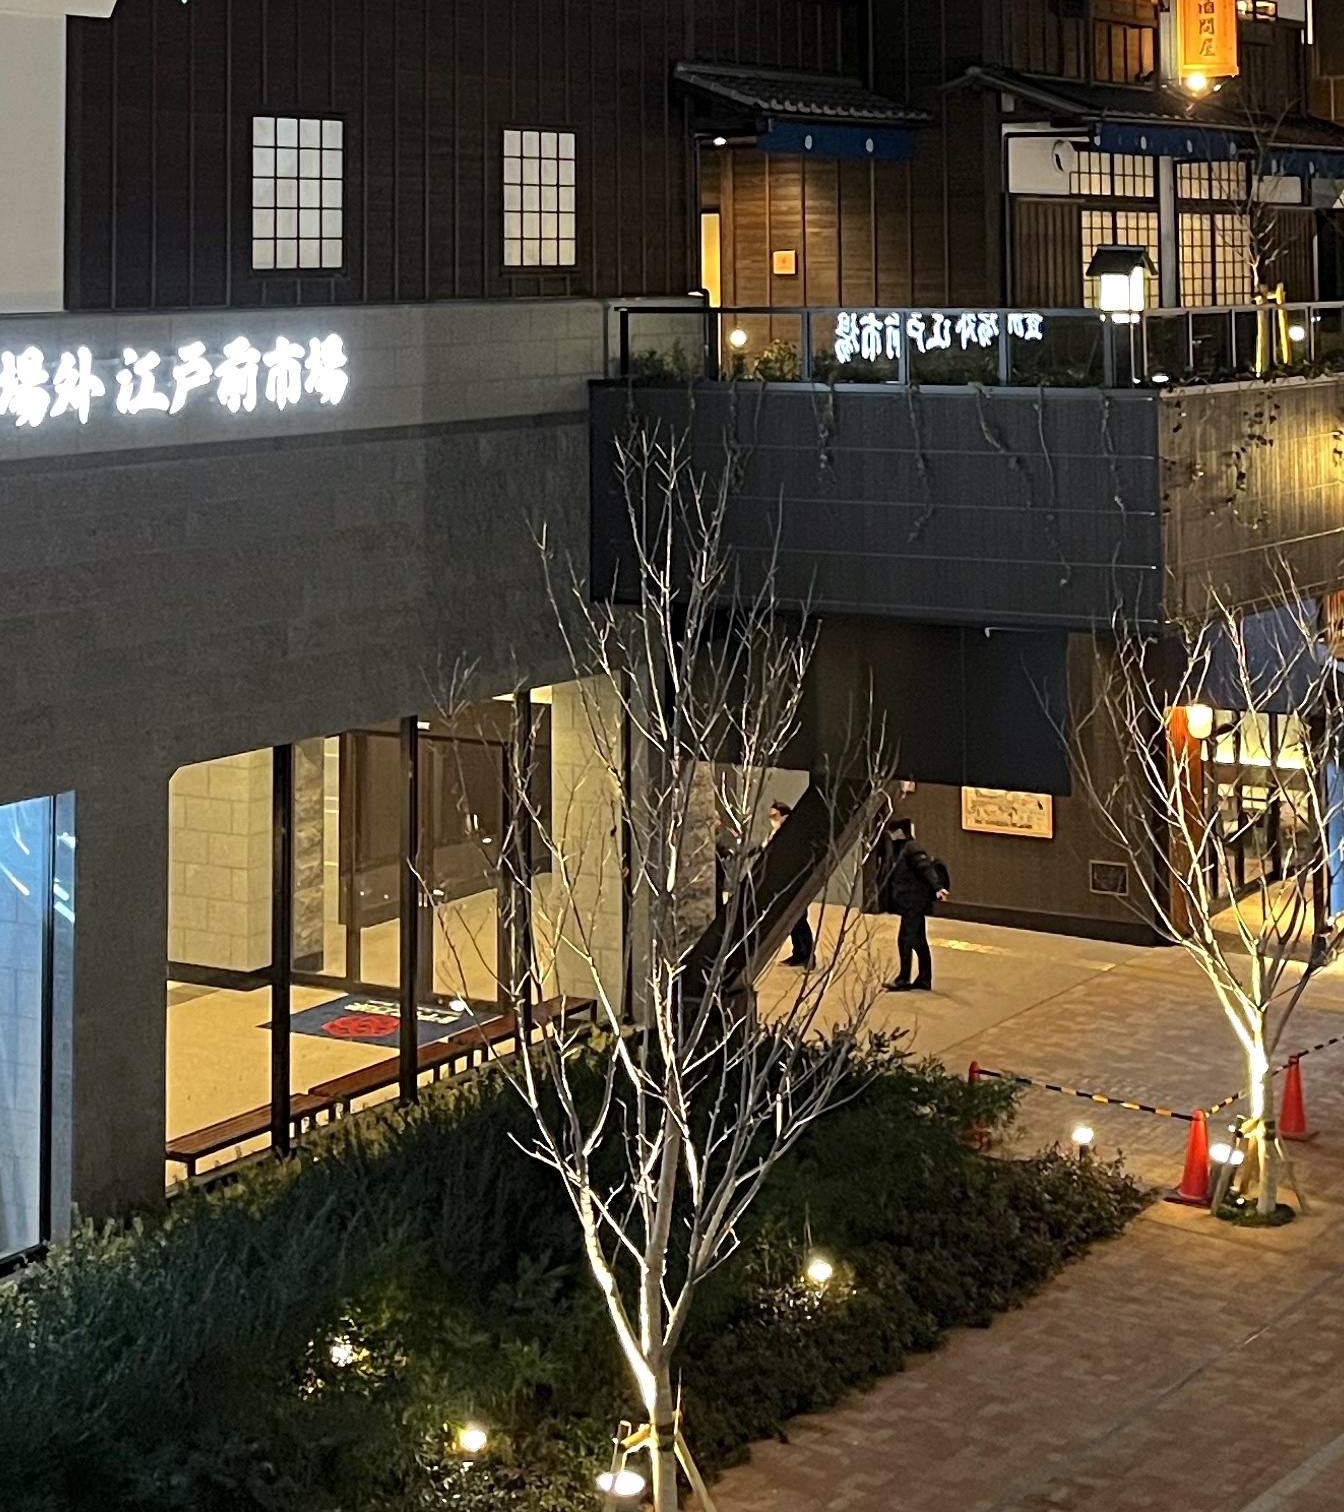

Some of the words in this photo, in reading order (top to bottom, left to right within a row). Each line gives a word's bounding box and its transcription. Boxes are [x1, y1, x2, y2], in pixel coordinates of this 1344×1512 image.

[115, 333, 349, 414] 江戸前市場
